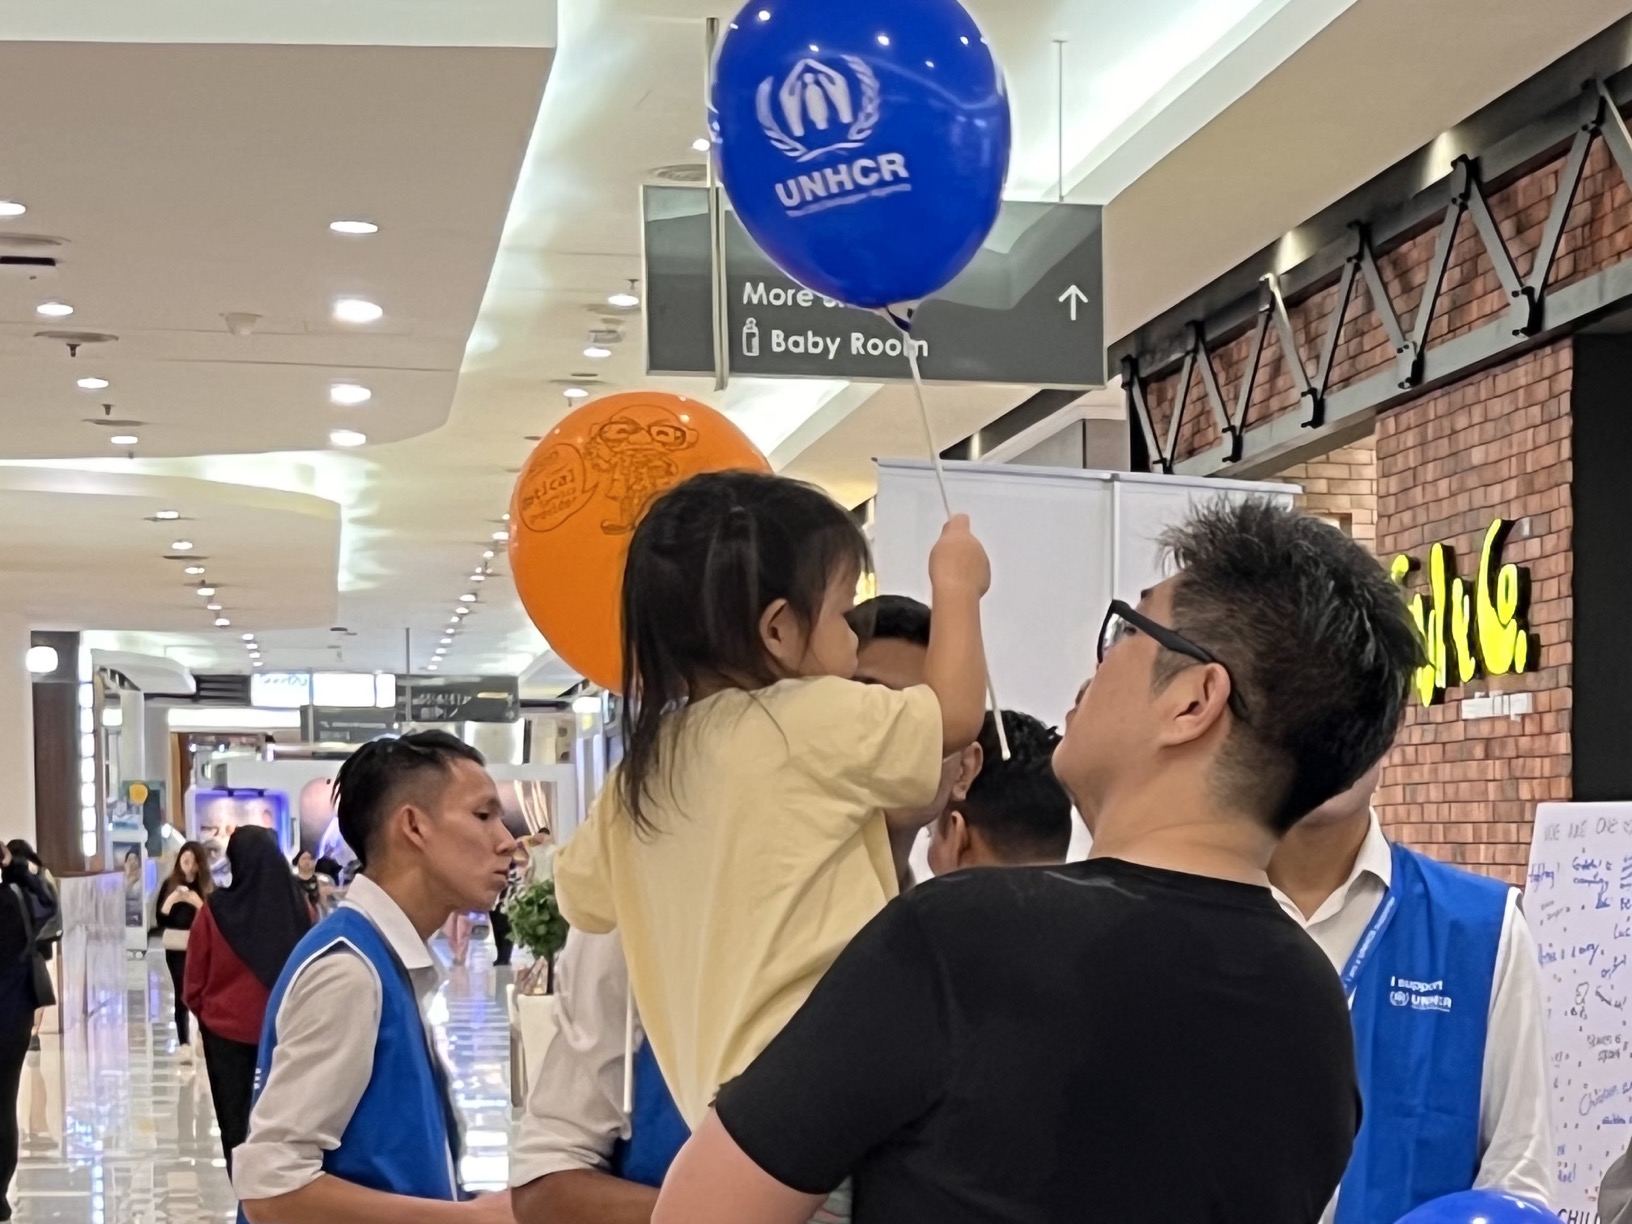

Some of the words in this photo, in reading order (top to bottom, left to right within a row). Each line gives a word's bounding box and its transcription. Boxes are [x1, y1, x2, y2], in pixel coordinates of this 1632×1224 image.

[773, 151, 910, 209] UNHCR
[742, 281, 814, 307] More
[771, 329, 841, 360] Baby
[1397, 978, 1443, 993] support
